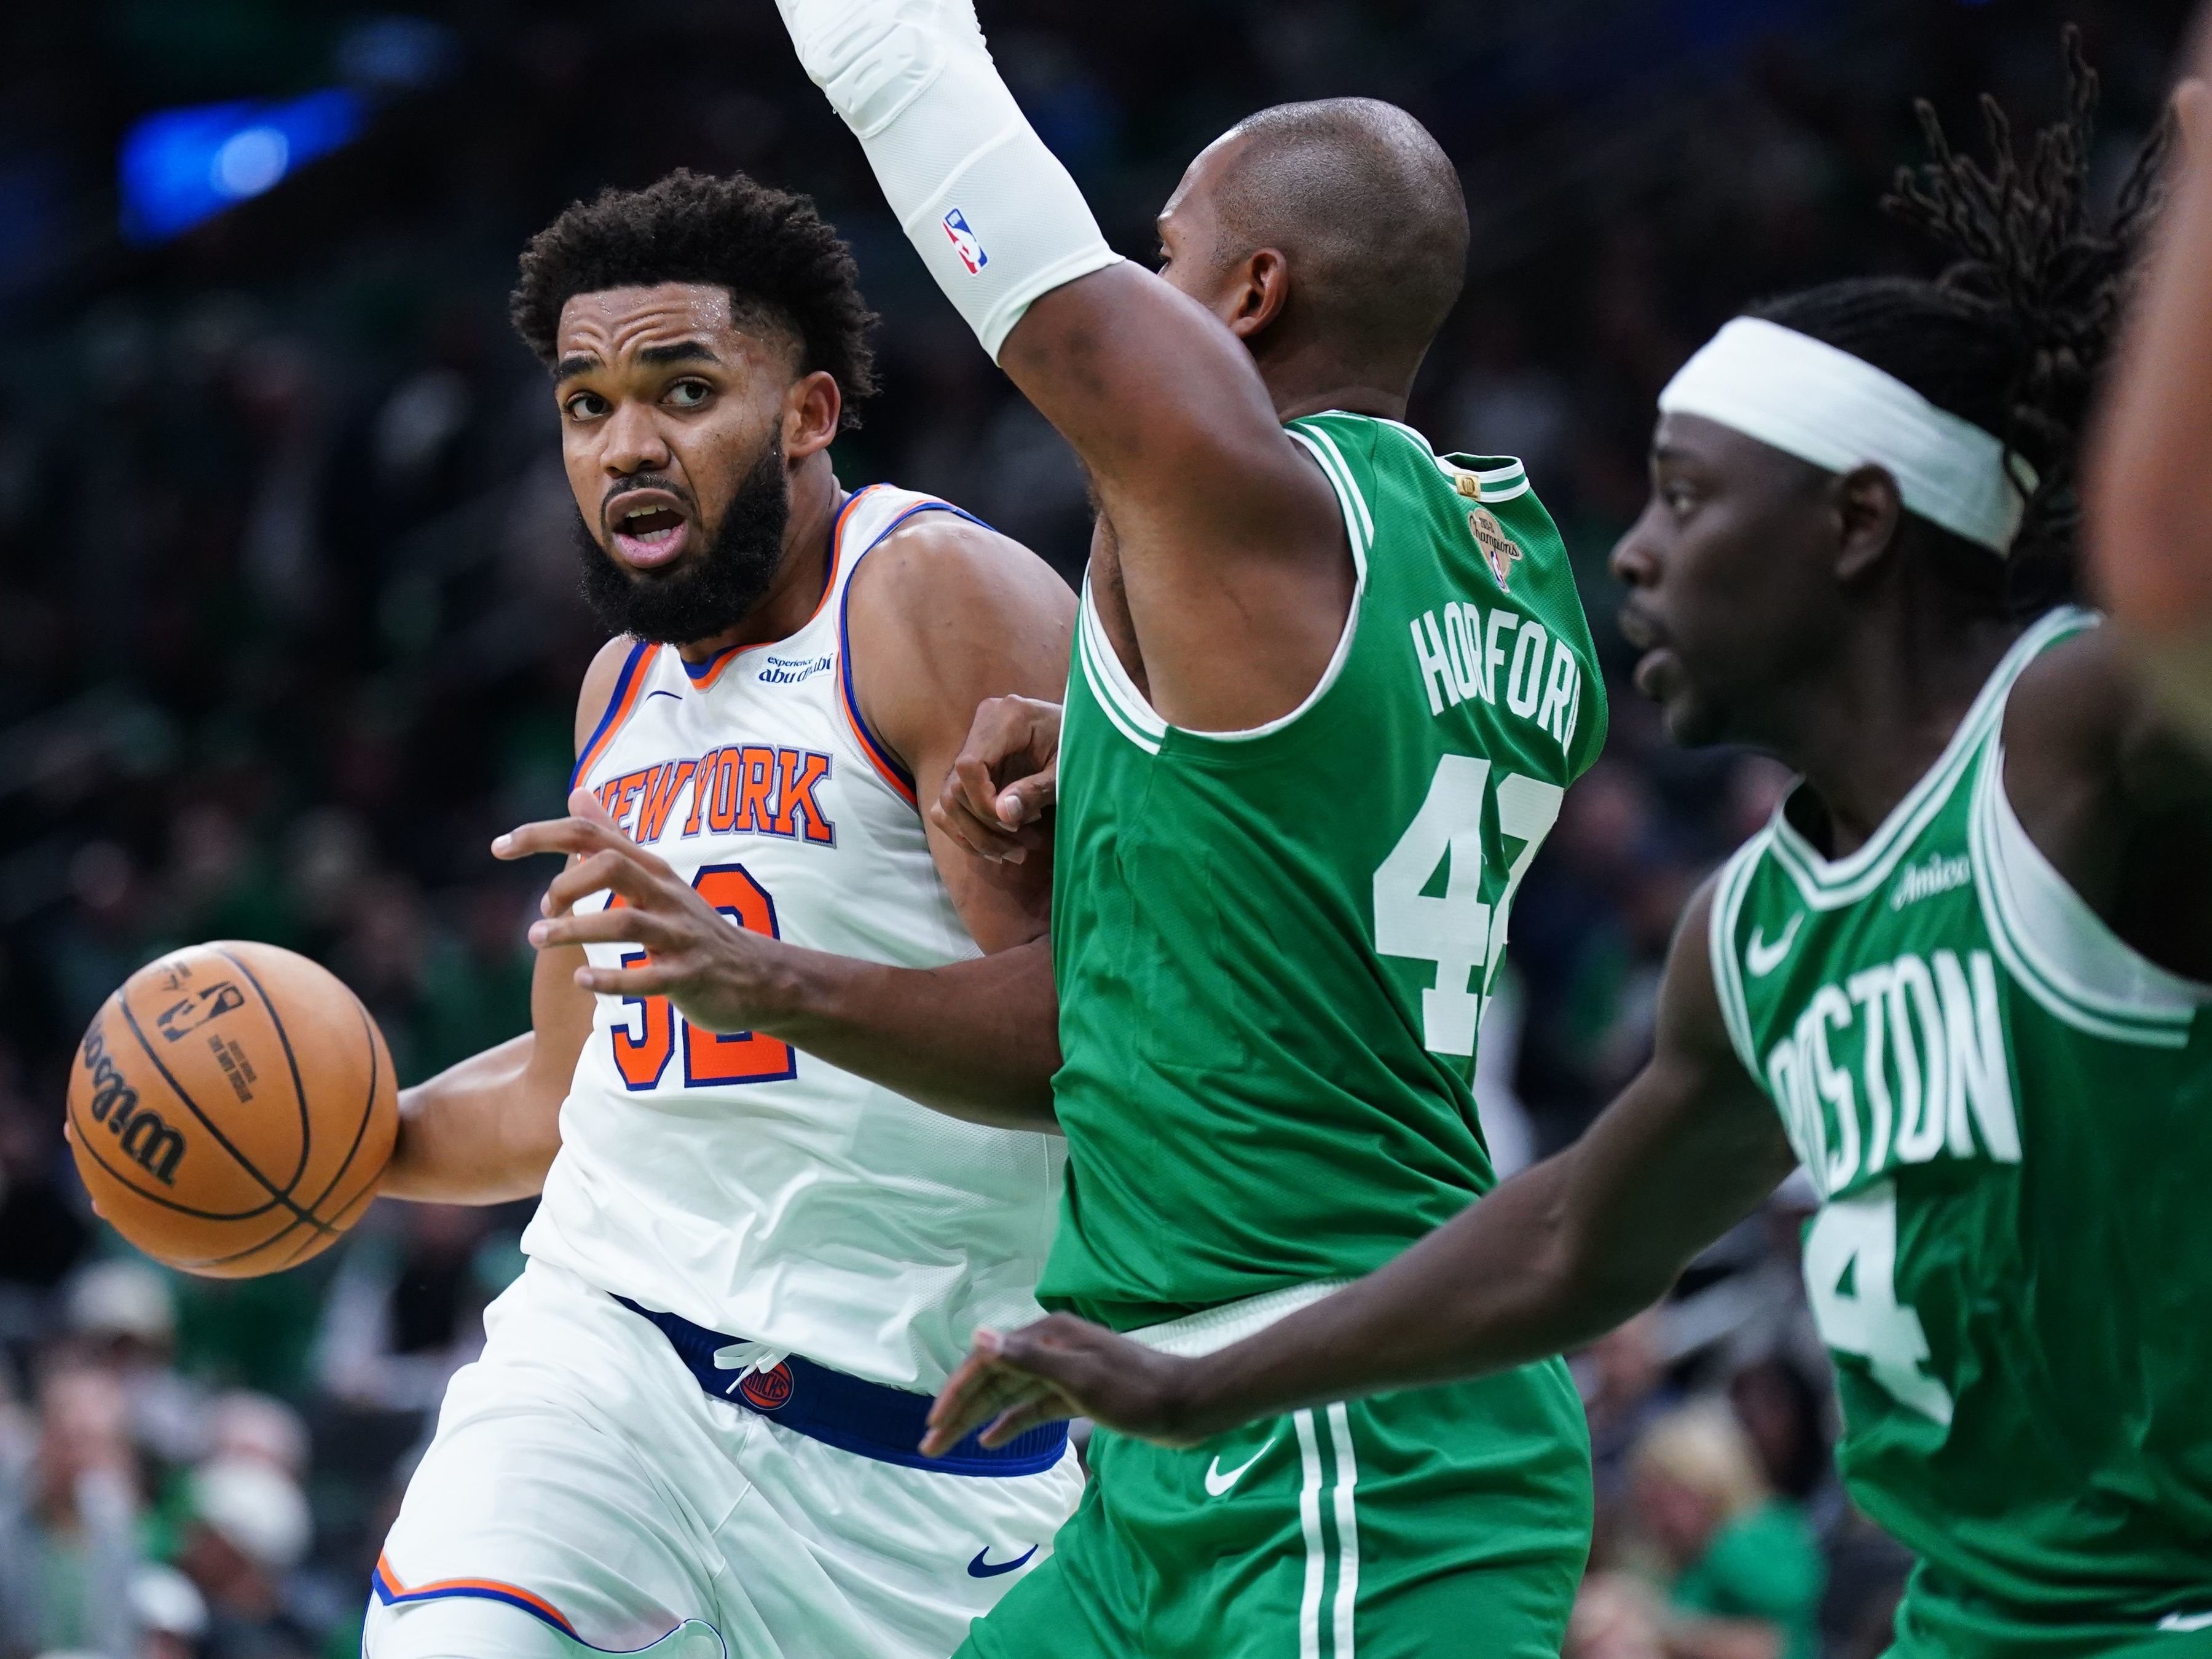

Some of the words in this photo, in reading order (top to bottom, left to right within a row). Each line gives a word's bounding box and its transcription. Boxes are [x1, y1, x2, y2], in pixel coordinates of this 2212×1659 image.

[758, 668, 796, 683] abu
[680, 744, 836, 848] YORK
[1373, 754, 1564, 1056] 42
[1803, 1178, 1955, 1426] 4
